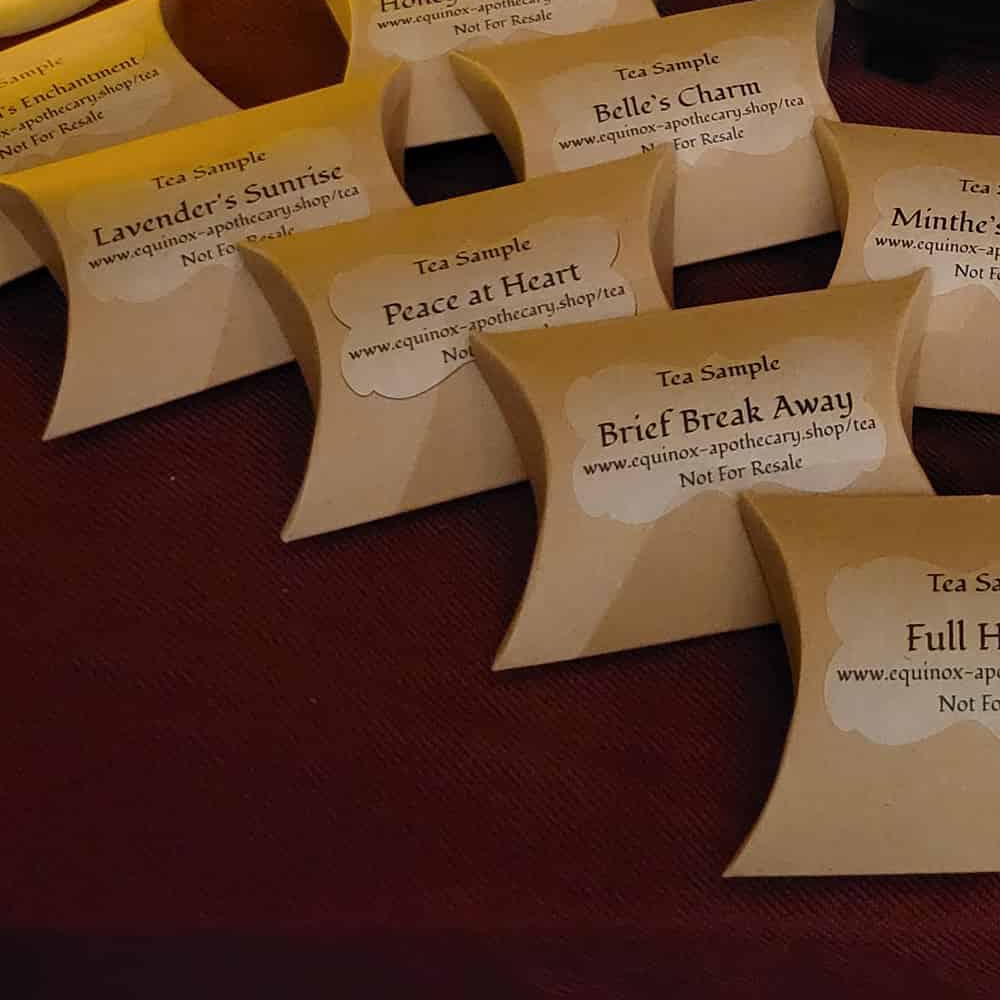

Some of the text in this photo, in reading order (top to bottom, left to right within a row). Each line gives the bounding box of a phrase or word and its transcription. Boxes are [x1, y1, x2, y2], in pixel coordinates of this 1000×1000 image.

[453, 10, 553, 36] Not For Resale
[21, 56, 139, 110] Enchantment
[614, 52, 720, 81] Tea Sample
[593, 79, 761, 123] Belle's Charm
[0, 111, 104, 160] Not For Resale
[558, 96, 804, 150] www.equinox-apothecary.shop/tea
[673, 136, 696, 151] For
[700, 126, 745, 147] Resale
[152, 151, 266, 190] Tea Sample
[959, 179, 990, 195] Tea
[92, 165, 344, 247] Lavender's Sunrise
[88, 186, 359, 270] www.equinox-apothecary.shop/tea
[181, 249, 213, 267] Not
[217, 243, 241, 257] Fo
[413, 238, 532, 275] Tea Sample
[954, 264, 984, 279] Not
[383, 263, 581, 326] Peace at Heart
[349, 285, 625, 361] www.equinox-apothecary.shop/tea
[442, 345, 474, 363] Not
[656, 355, 781, 388] Tea Sample
[598, 391, 854, 448] Brief Break Away
[583, 417, 876, 475] www.equinox-apothecary.shop/tea
[679, 454, 803, 488] Not For Resale
[928, 573, 967, 593] Tea
[906, 619, 966, 651] Full
[939, 694, 975, 713] Not
